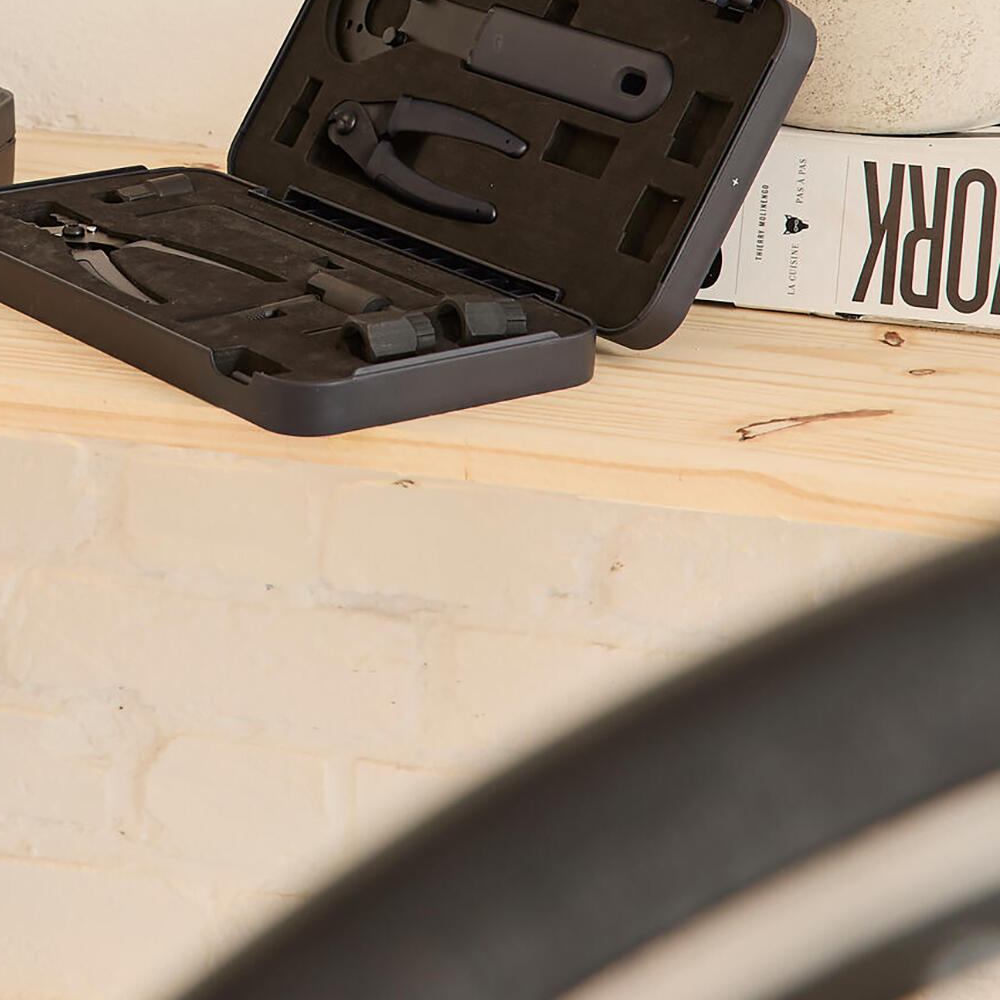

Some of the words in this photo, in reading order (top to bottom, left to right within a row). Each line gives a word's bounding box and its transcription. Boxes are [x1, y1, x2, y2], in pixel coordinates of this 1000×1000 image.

[798, 158, 807, 175] PAS
[759, 184, 769, 227] MOLINENGO
[795, 187, 805, 204] PAS
[755, 230, 765, 261] THIERRY
[789, 244, 800, 282] CUISINE
[787, 284, 796, 296] LA
